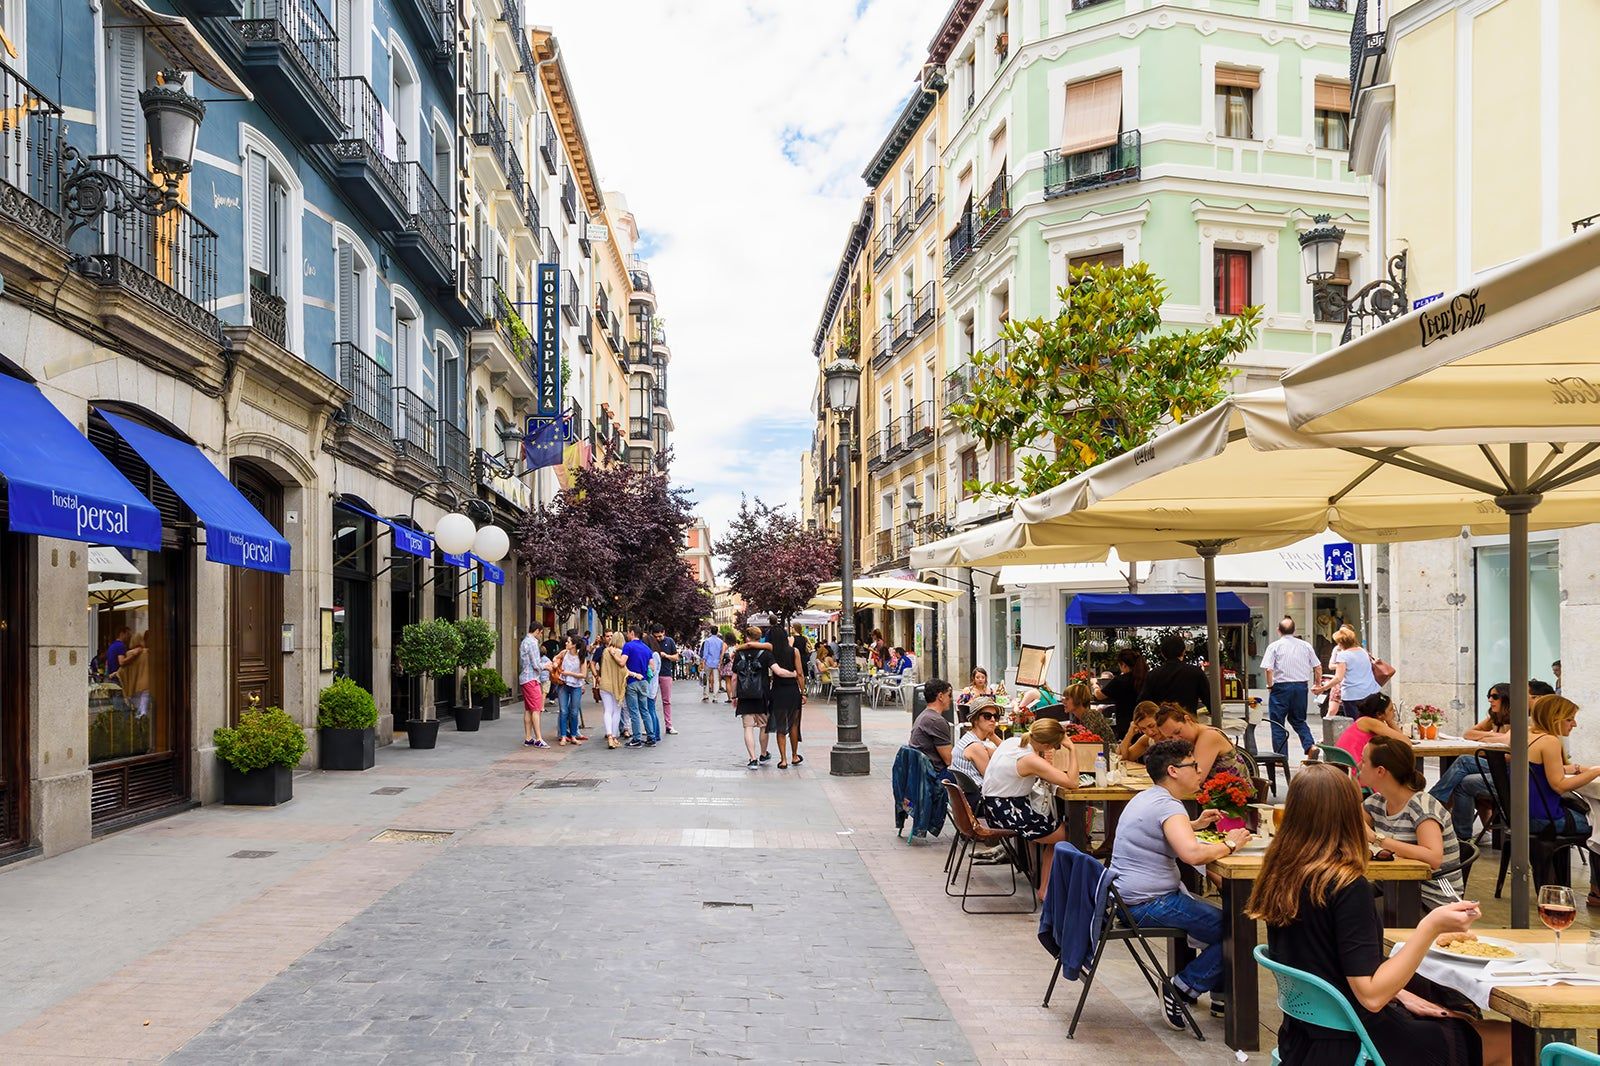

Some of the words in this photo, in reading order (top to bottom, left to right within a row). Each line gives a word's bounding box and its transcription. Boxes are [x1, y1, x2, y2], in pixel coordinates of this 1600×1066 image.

[543, 270, 555, 343] HOSTAL
[543, 349, 555, 409] PLAZA
[52, 489, 79, 510] hostal
[77, 504, 130, 536] persal
[229, 532, 244, 546] hostal
[242, 541, 273, 565] persal
